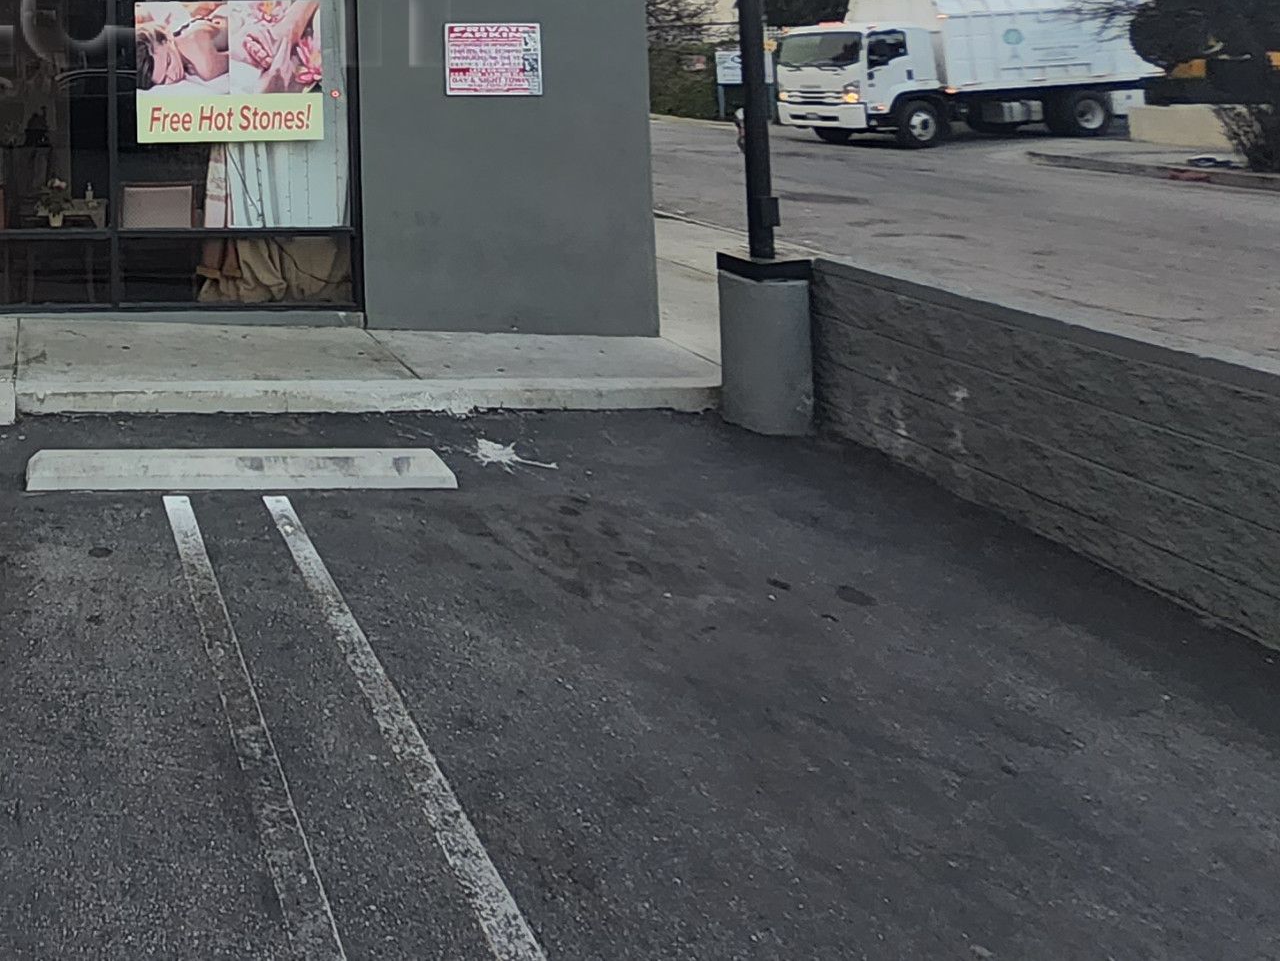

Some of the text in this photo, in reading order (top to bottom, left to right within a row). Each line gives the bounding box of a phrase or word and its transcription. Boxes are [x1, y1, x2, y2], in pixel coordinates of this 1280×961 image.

[149, 104, 312, 133] Free Hot Stones!
